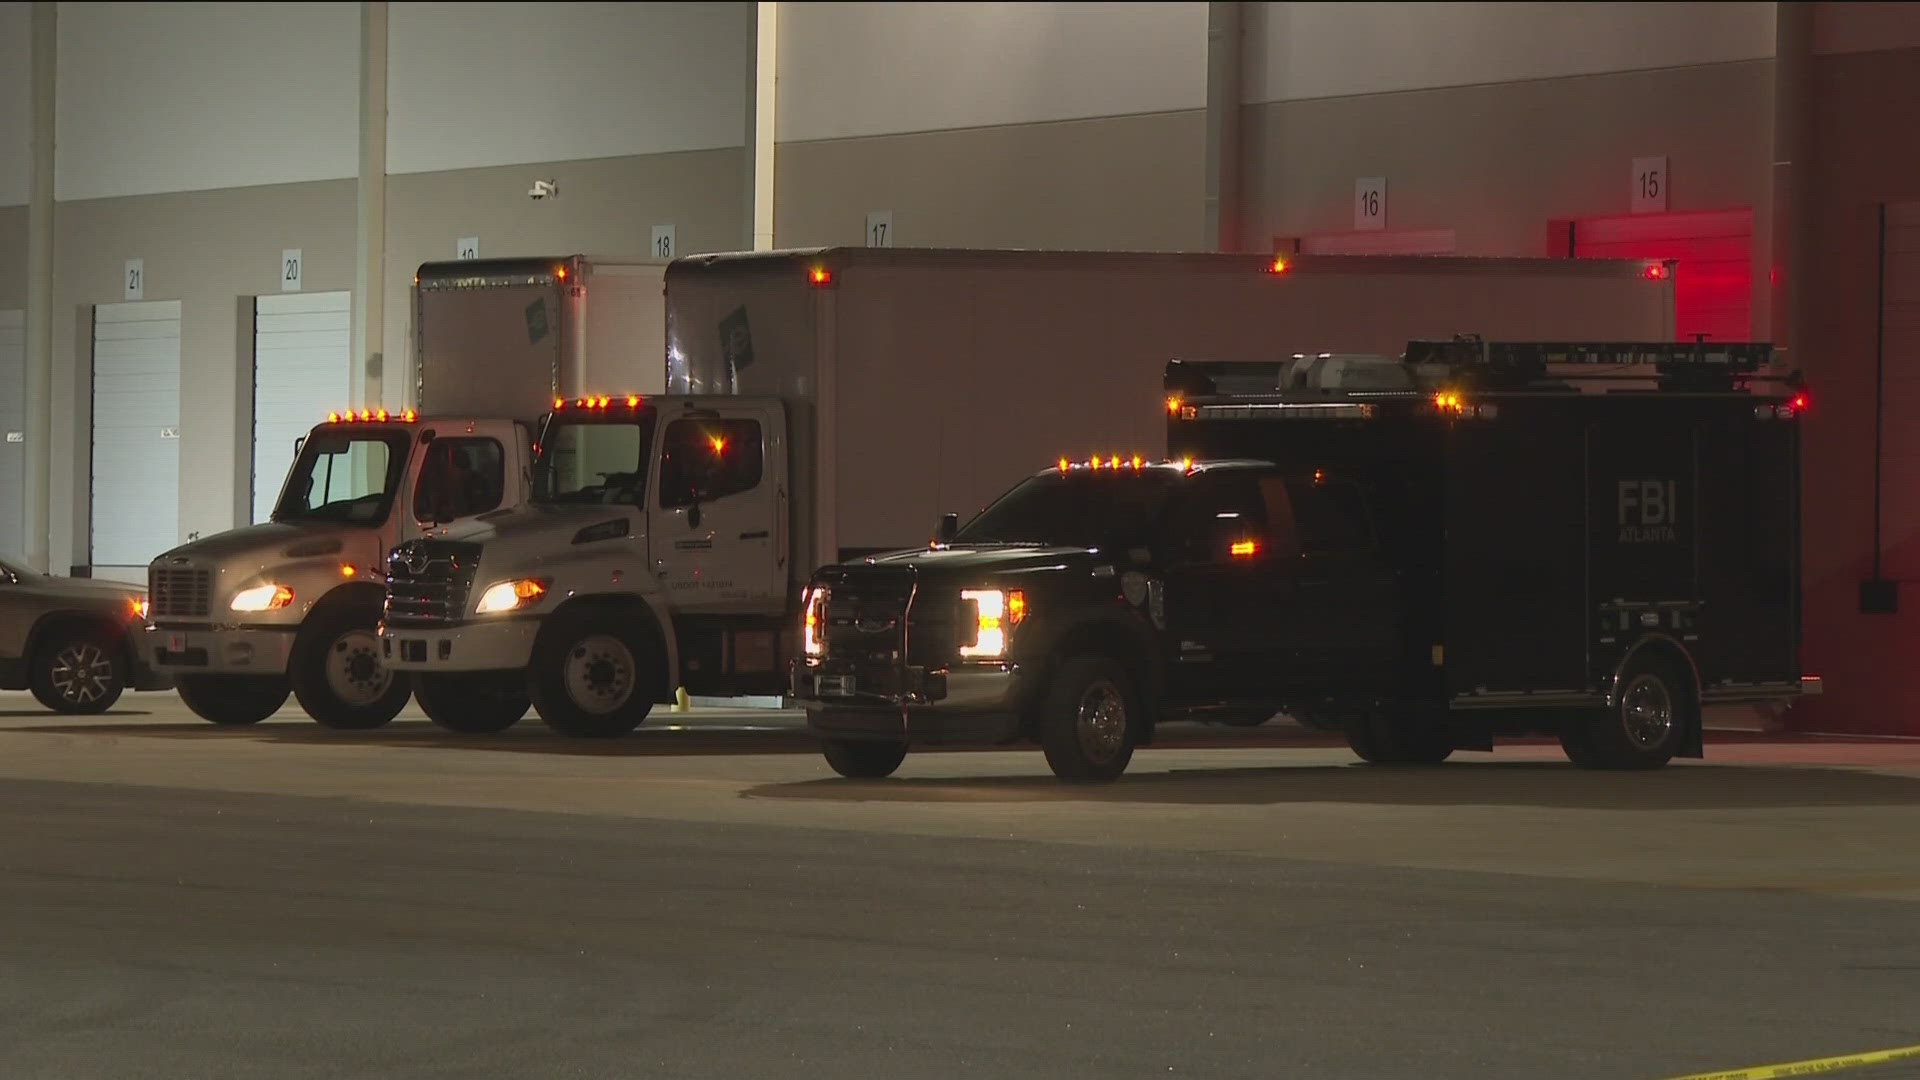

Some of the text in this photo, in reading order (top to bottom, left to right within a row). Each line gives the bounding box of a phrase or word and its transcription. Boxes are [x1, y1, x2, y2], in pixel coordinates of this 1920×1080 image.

[1640, 171, 1659, 199] 15
[1361, 191, 1379, 216] 16
[873, 223, 887, 247] 17
[657, 236, 670, 258] 18
[129, 270, 140, 289] 21
[286, 260, 298, 280] 20
[1618, 480, 1676, 524] FBI
[1618, 526, 1676, 543] ATLANTA
